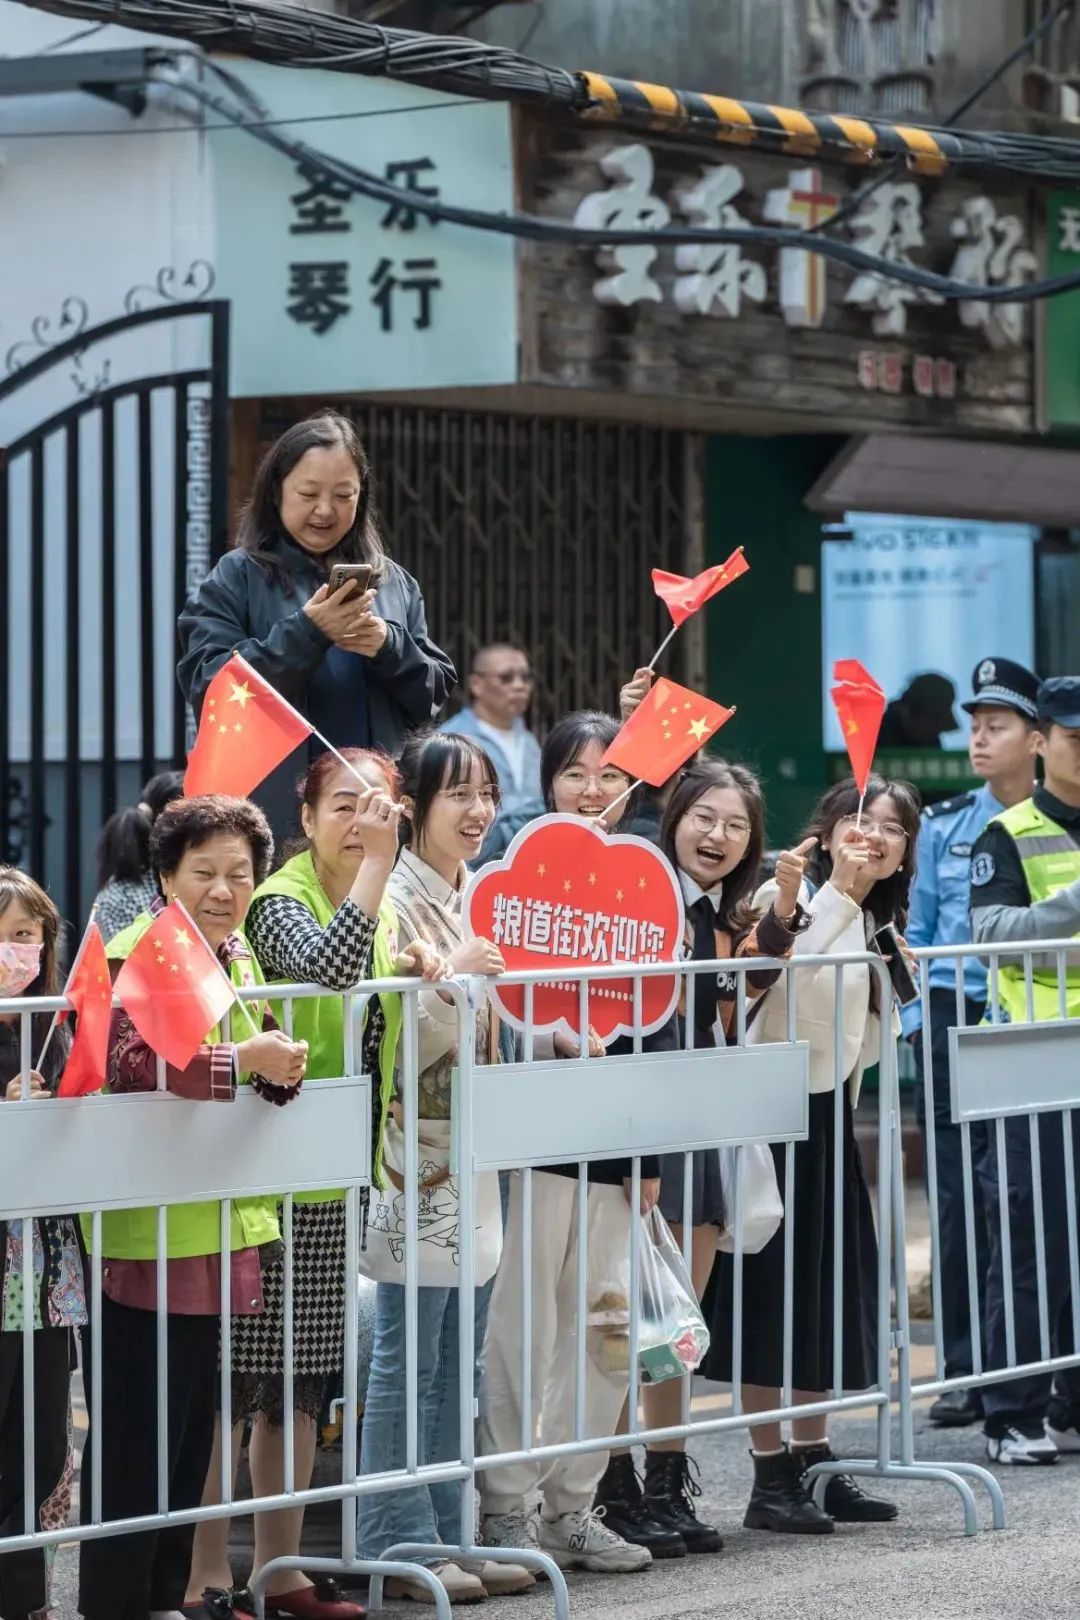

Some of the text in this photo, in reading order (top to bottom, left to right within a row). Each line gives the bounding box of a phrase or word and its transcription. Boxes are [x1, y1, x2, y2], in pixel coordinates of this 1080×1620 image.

[286, 257, 441, 337] 琴行
[492, 893, 666, 966] 粮道街欢迎您
